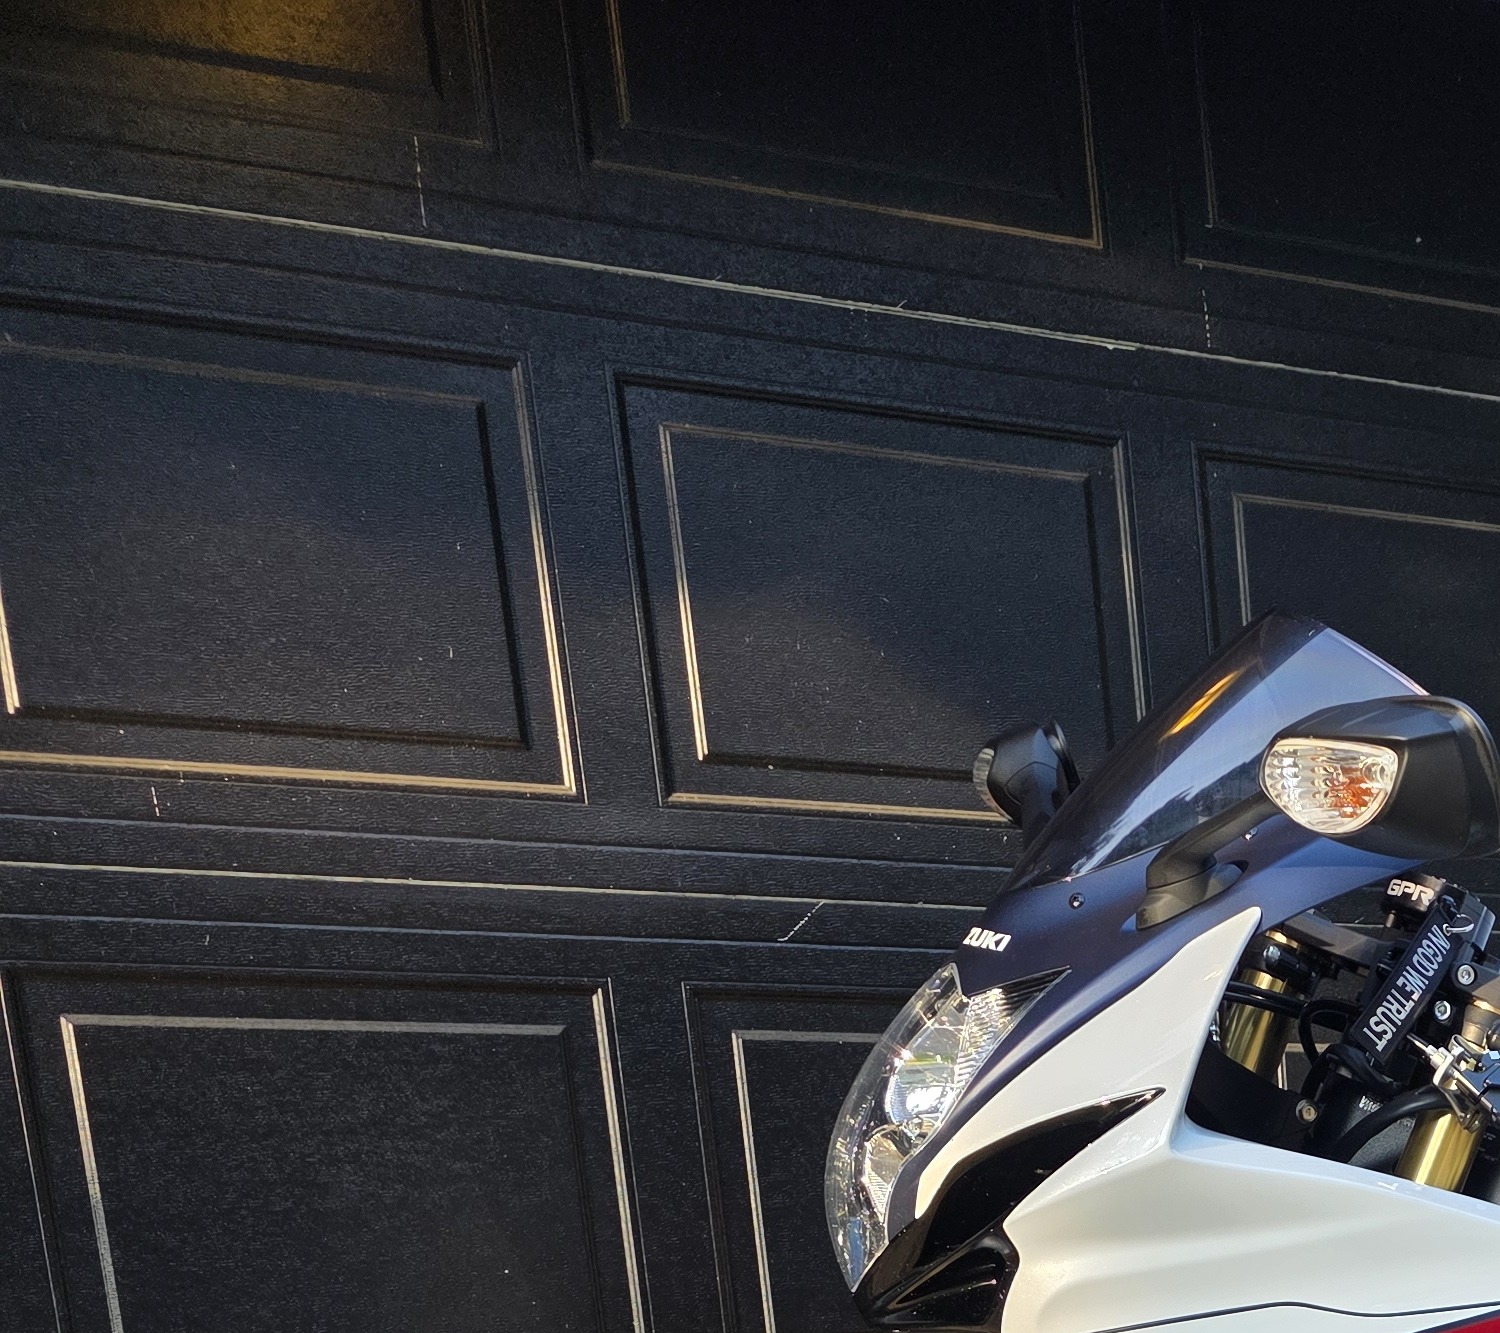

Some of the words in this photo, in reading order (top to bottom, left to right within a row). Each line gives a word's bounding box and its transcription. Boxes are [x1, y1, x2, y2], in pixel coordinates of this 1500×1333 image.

[1386, 878, 1436, 906] GPR
[1427, 924, 1451, 955] IN
[1412, 939, 1443, 977] GOD
[1396, 965, 1429, 1001] WE
[1362, 988, 1415, 1052] TRUST
